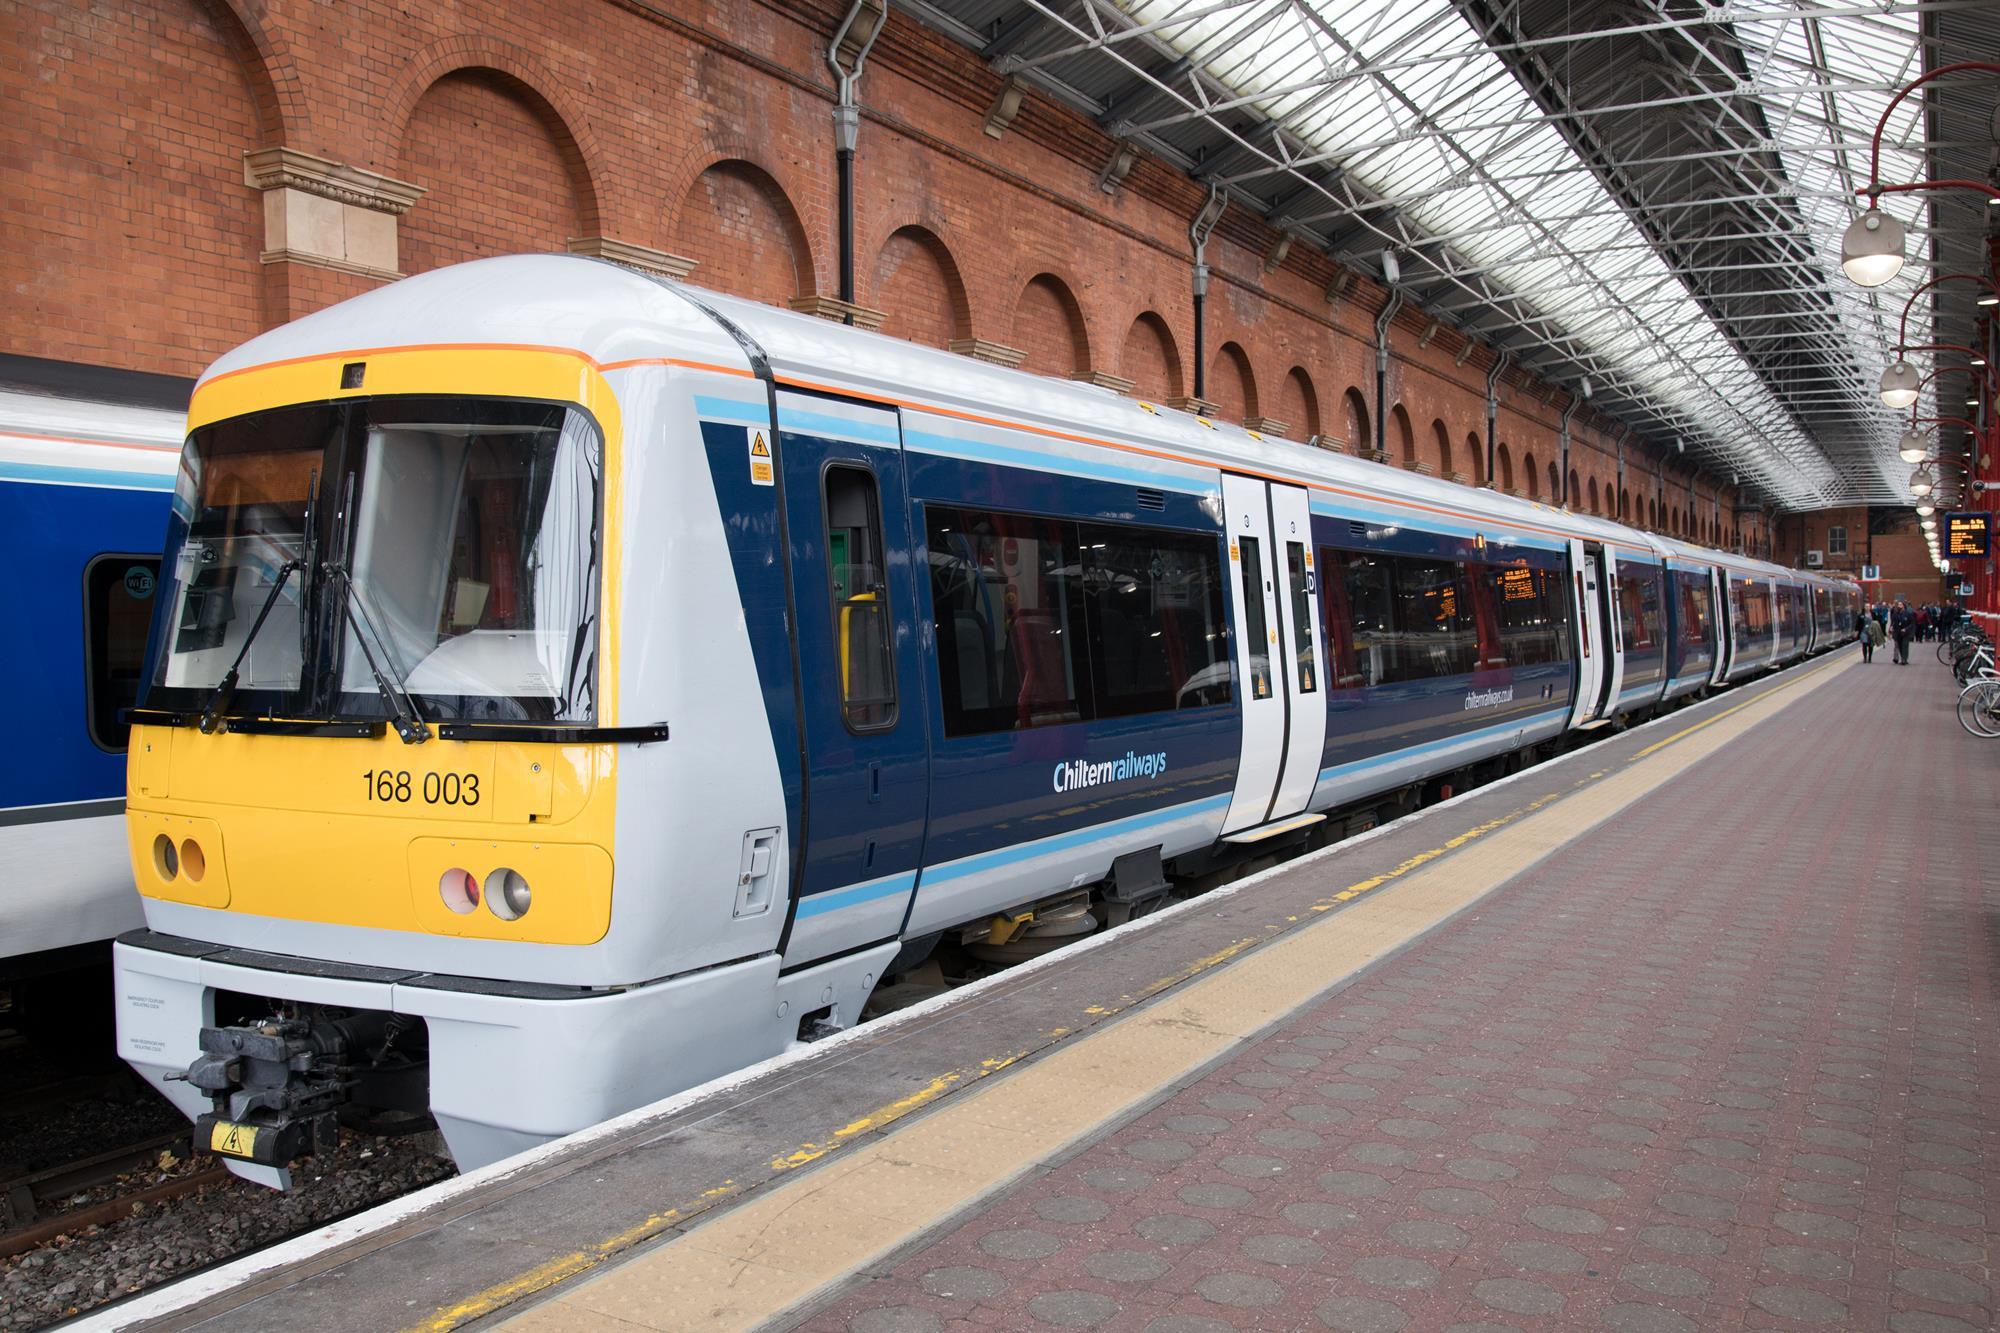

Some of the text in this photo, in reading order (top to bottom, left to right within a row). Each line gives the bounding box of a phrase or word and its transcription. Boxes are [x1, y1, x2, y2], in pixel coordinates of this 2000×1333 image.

[1308, 575, 1315, 591] D
[363, 769, 480, 806] 168 003
